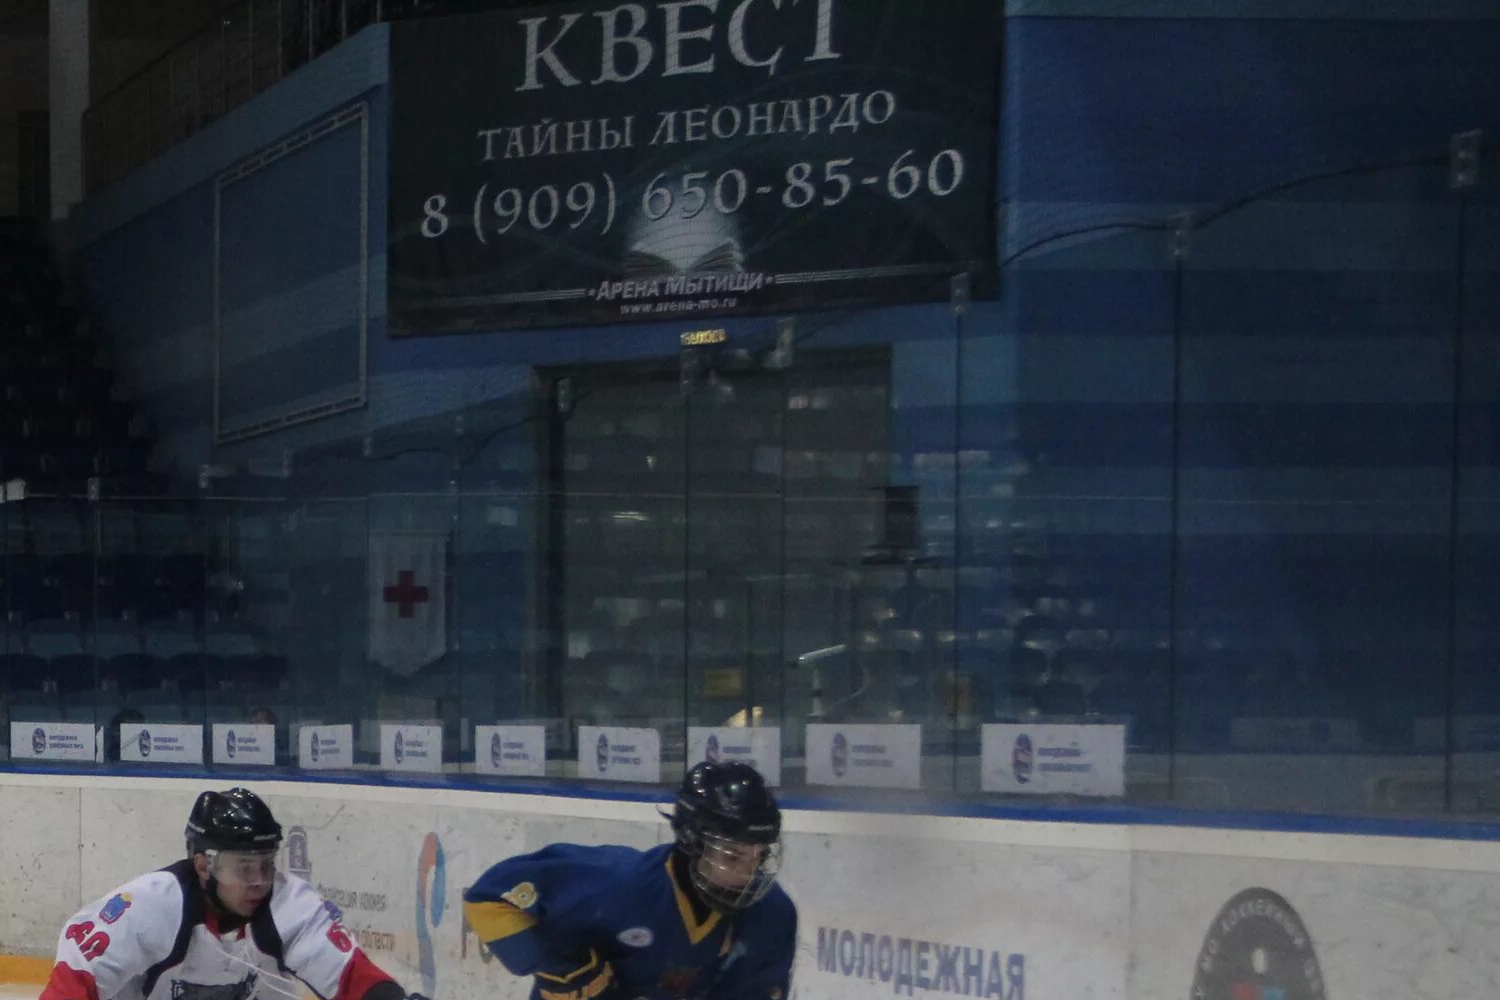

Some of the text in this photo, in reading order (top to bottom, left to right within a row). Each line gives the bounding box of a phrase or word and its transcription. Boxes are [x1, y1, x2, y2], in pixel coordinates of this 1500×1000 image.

[514, 0, 843, 92] КВЕСТ
[477, 90, 896, 161] ТАЙНЫ ЛЕОНАРДО
[419, 147, 965, 244] 8 (909) 650-85-60
